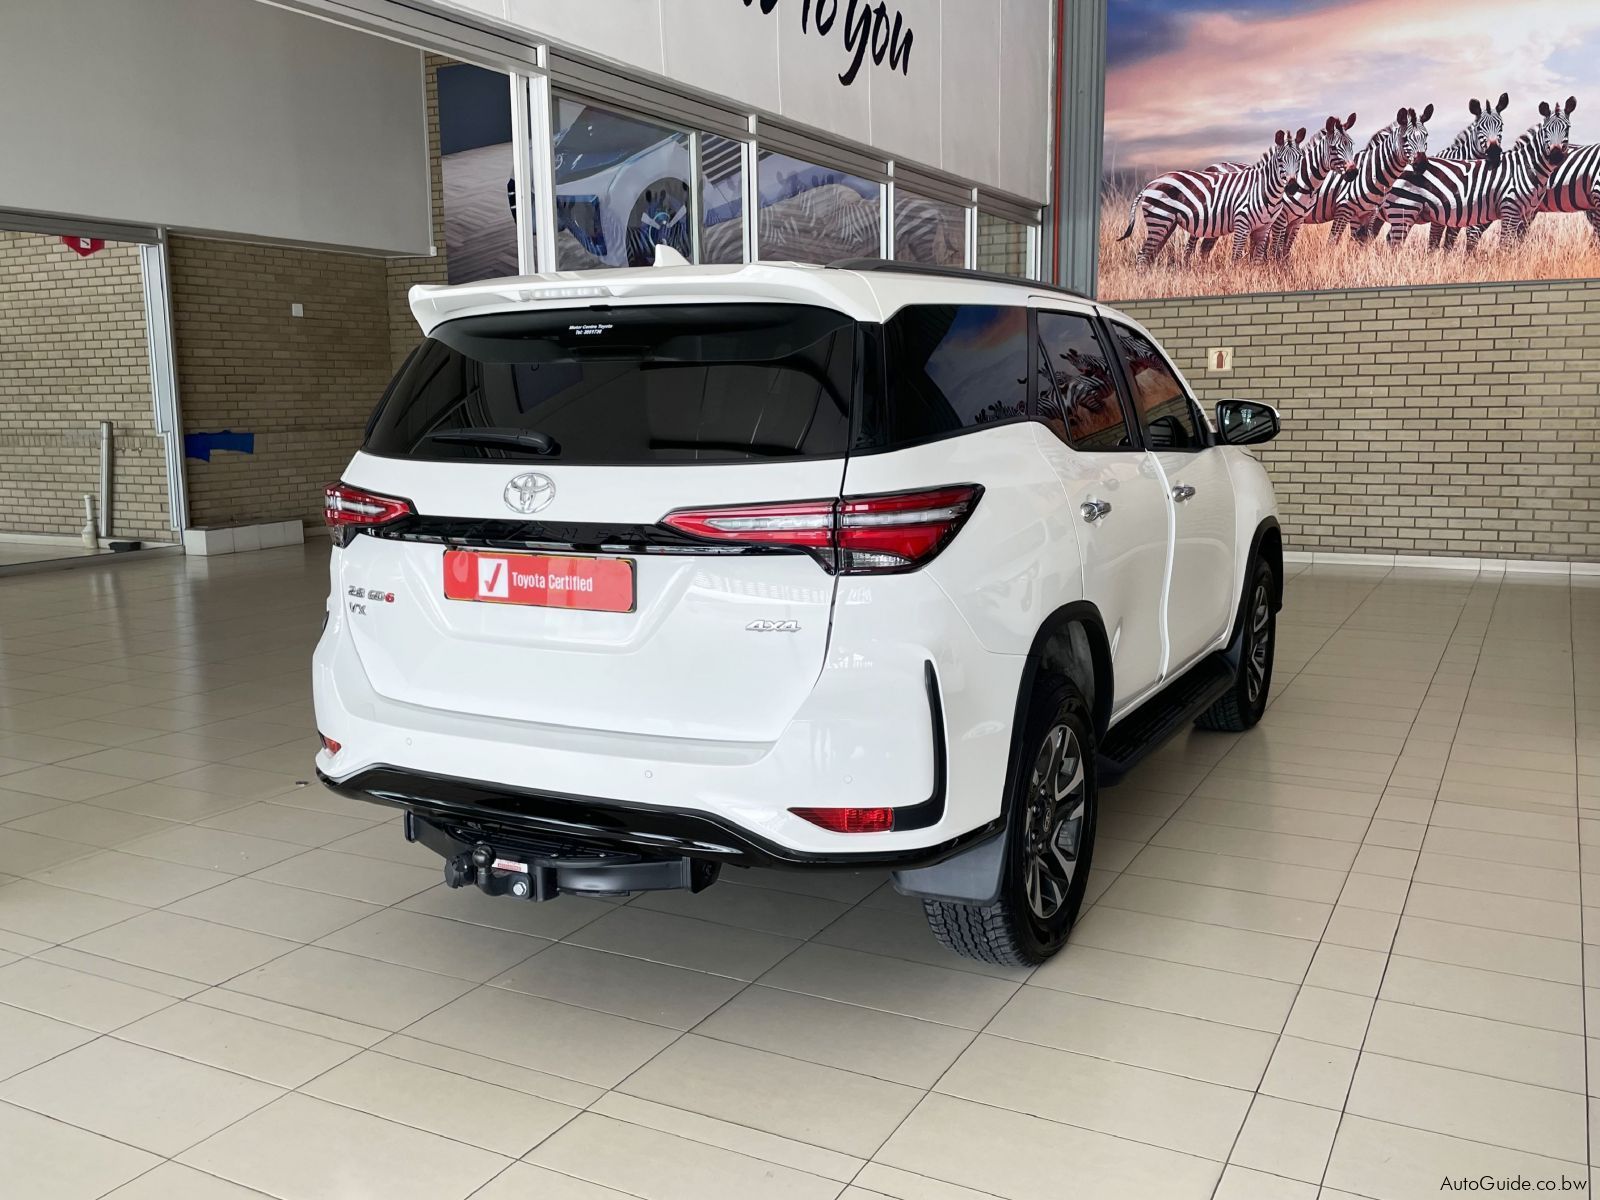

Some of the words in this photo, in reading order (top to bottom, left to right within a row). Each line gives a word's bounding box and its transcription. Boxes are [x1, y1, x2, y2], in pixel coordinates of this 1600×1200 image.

[838, 0, 913, 86] you
[512, 571, 545, 589] Toyota
[548, 574, 593, 592] Certified
[349, 602, 366, 616] VX
